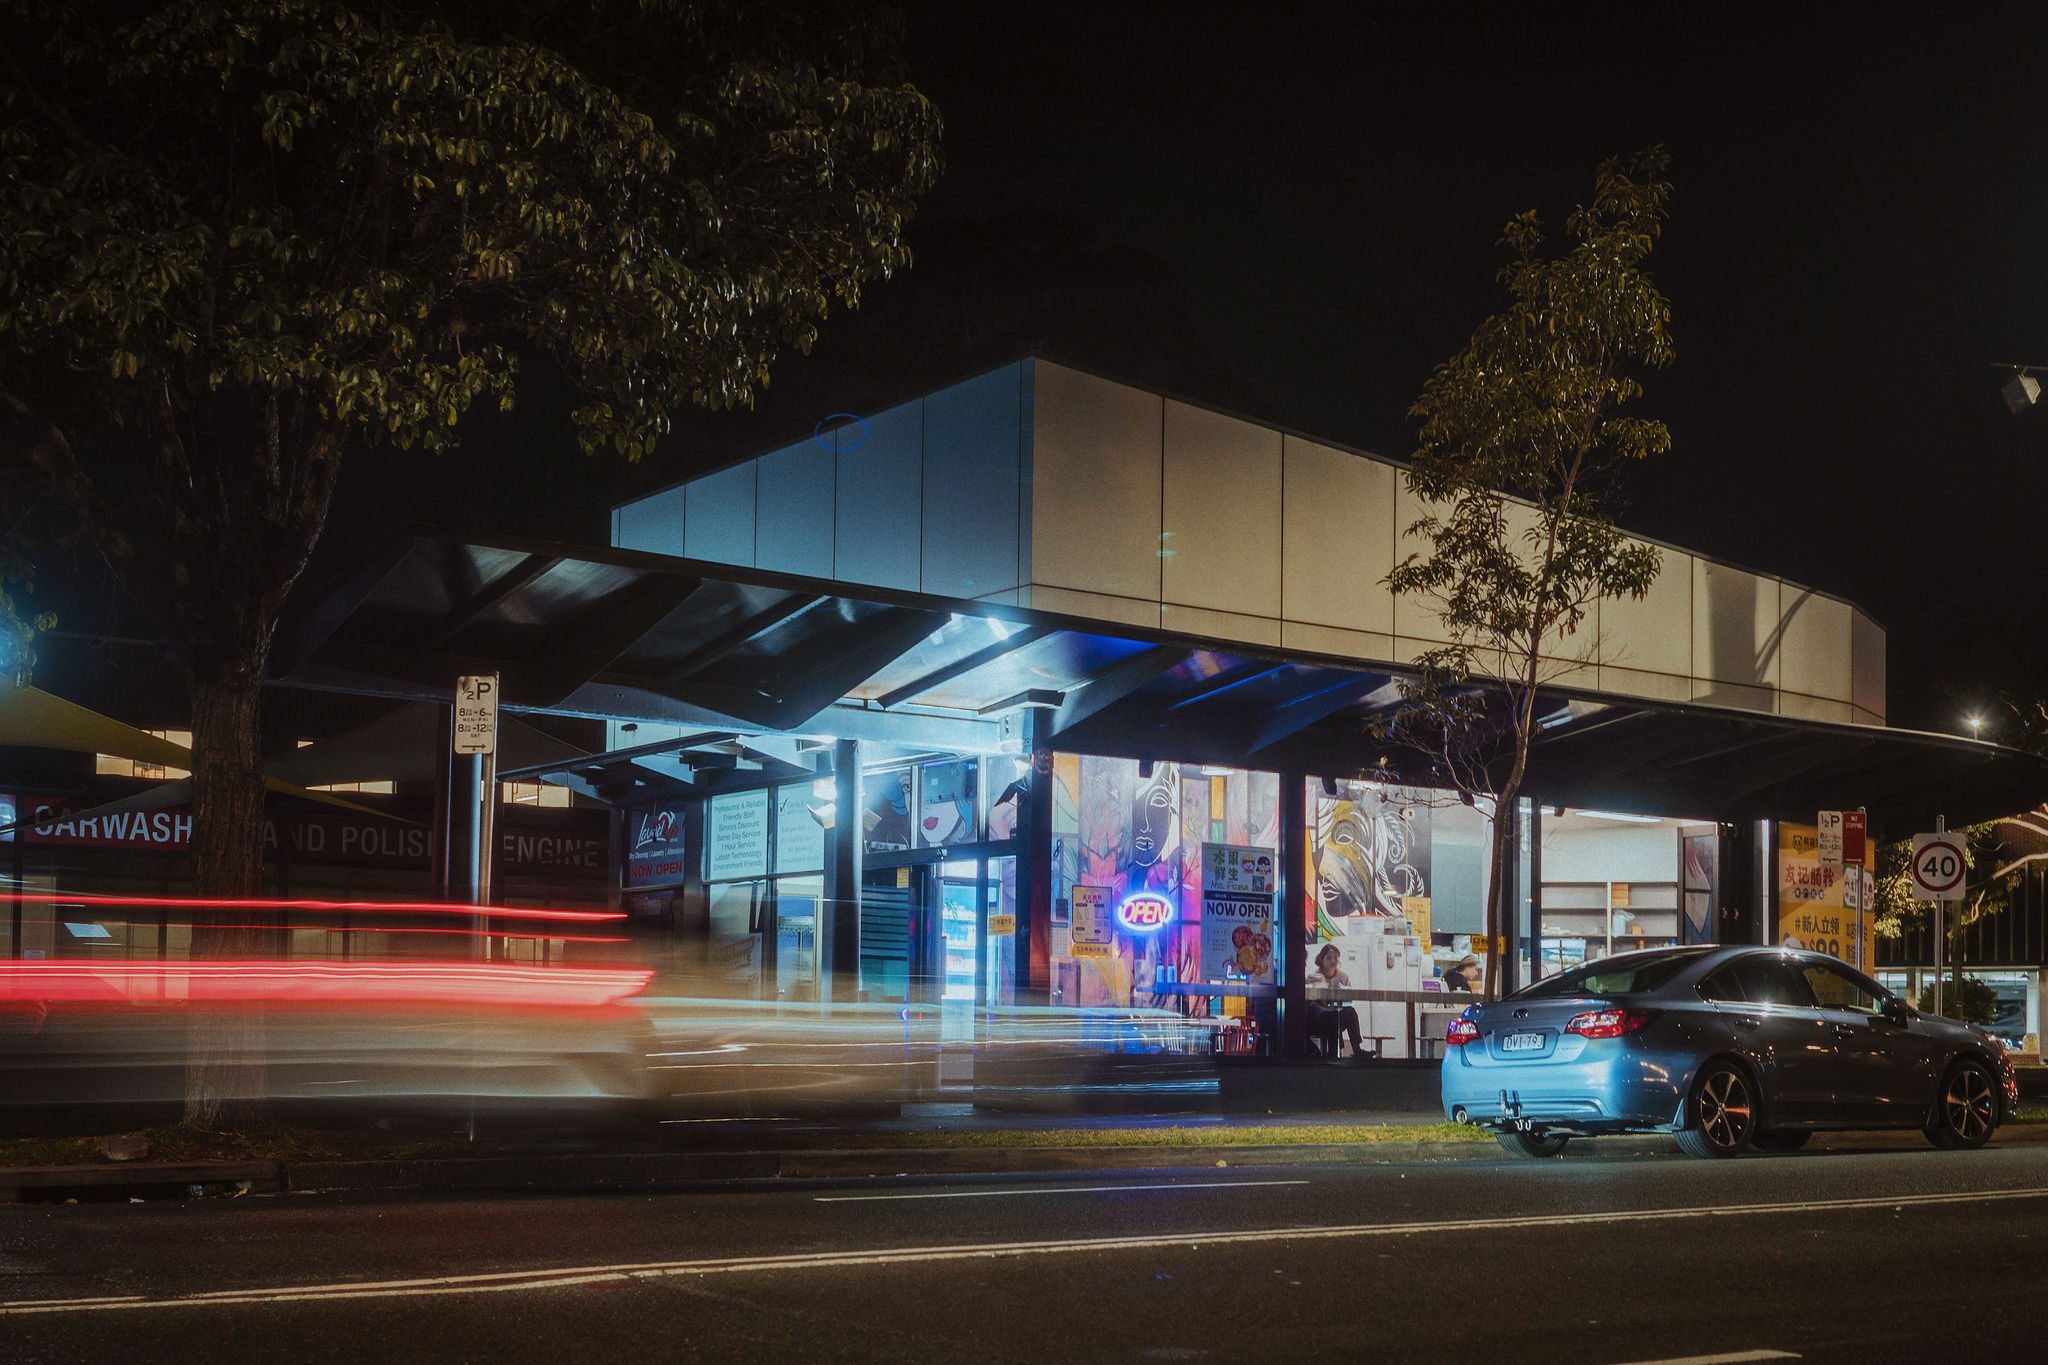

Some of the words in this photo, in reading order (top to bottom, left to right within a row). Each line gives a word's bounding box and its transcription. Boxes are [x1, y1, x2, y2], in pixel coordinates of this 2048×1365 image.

[723, 812, 742, 821] Friendly
[743, 811, 755, 819] Staff
[719, 824, 737, 832] Seniors
[738, 821, 759, 829] Discount
[1845, 821, 1864, 829] STOPPING
[716, 834, 730, 842] Same
[732, 832, 741, 840] Day
[742, 830, 761, 838] Service
[738, 841, 756, 849] Service
[504, 835, 599, 867] ENGINE
[715, 853, 730, 861] Latest
[630, 864, 653, 878] NOW
[656, 861, 682, 876] OPEN
[713, 862, 743, 871] Environment
[744, 860, 763, 868] Friendly
[1922, 856, 1956, 877] 40
[1123, 901, 1168, 924] OPEN
[1206, 901, 1236, 916] NOW
[1239, 903, 1269, 919] OPEN
